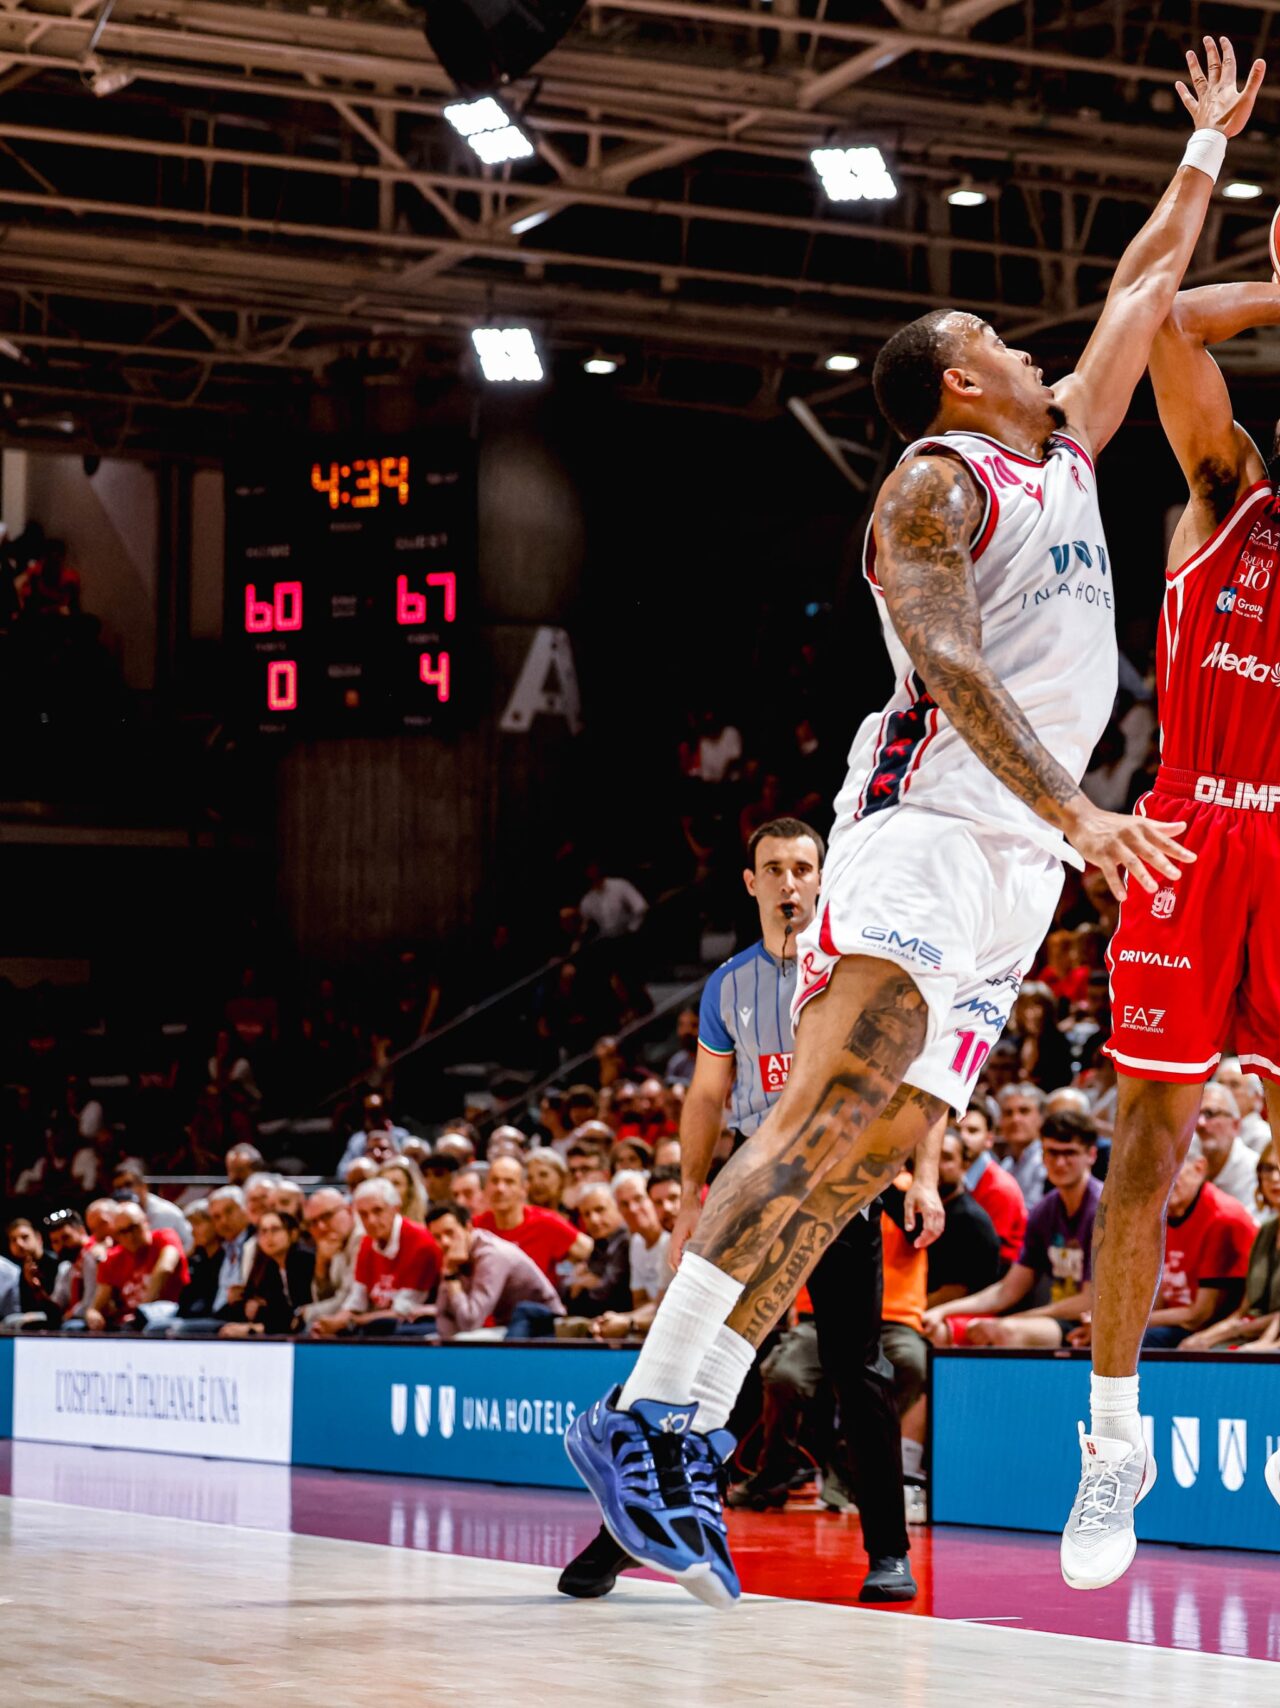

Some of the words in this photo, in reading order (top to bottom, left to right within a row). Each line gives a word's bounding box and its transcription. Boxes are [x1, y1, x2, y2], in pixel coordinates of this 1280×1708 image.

[311, 456, 409, 509] 4:39
[245, 581, 302, 633] 60
[396, 572, 456, 624] 67
[1075, 581, 1112, 609] HOTE
[268, 660, 297, 711] 0
[420, 652, 450, 702] 4
[861, 926, 943, 965] GME
[1119, 949, 1192, 969] DRIVALIA
[1123, 1005, 1166, 1028] EA7
[767, 1053, 793, 1073] AT
[463, 1396, 501, 1431] UNA
[505, 1399, 576, 1435] HOTELS
